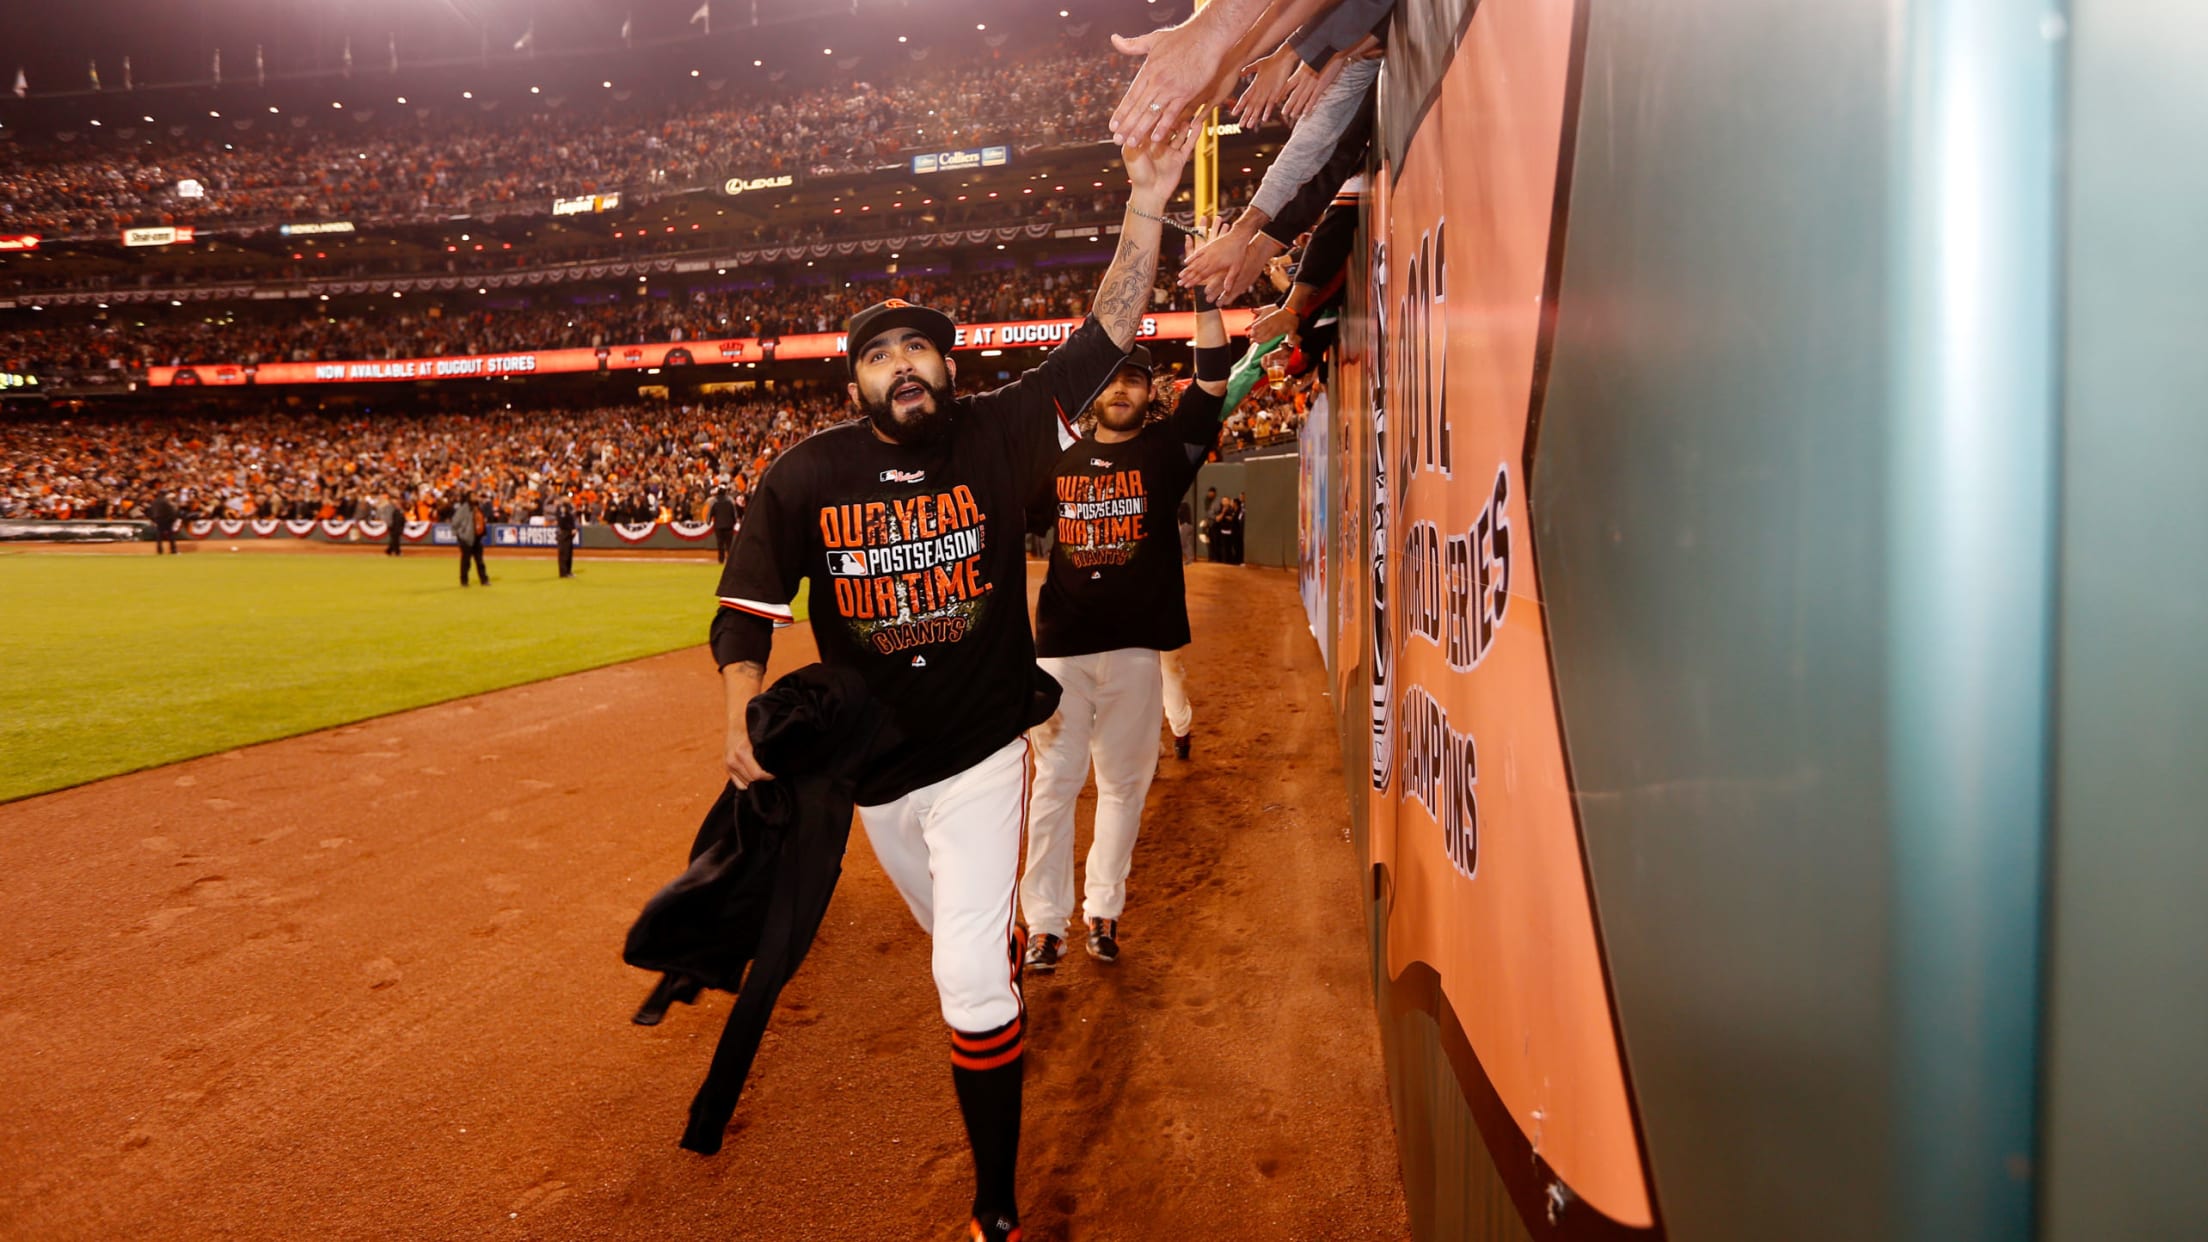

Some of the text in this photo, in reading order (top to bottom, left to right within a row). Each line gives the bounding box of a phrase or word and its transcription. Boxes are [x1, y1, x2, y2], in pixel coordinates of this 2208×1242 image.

[743, 175, 793, 191] LEXUS
[973, 327, 995, 345] AT
[1001, 323, 1073, 344] DUGOUT
[315, 355, 537, 379] NOW AVAILABLE AT DUGOUT STORES
[1056, 475, 1090, 503] OUR
[819, 484, 987, 549] OUR YEAR.
[1076, 497, 1141, 520] POSTSEASON
[1057, 514, 1148, 545] OUR TIME.
[869, 527, 979, 576] POSTSEASON
[1071, 549, 1129, 569] GIANTS
[834, 554, 993, 620] OUR TIME.
[1399, 519, 1441, 659] WORLD
[871, 616, 967, 656] GIANTS
